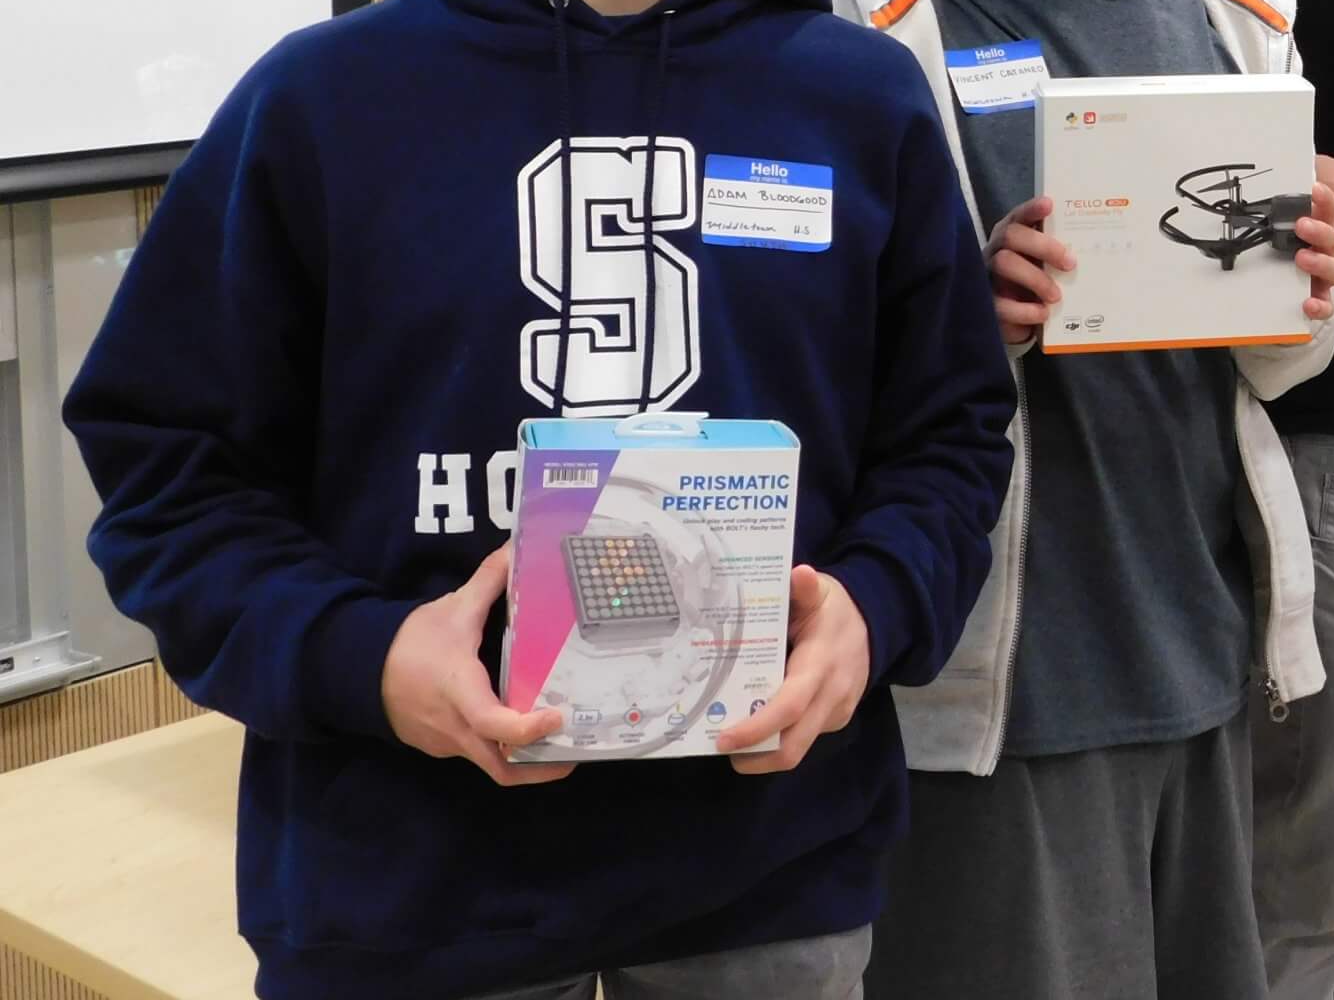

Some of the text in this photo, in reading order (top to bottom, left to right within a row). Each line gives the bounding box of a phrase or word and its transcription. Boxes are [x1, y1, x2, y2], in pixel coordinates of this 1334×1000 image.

[975, 47, 1006, 60] Hello
[751, 162, 789, 177] Hello
[707, 187, 748, 201] ADAM
[679, 475, 790, 491] PRISMATIC
[662, 494, 789, 511] PERFECTION
